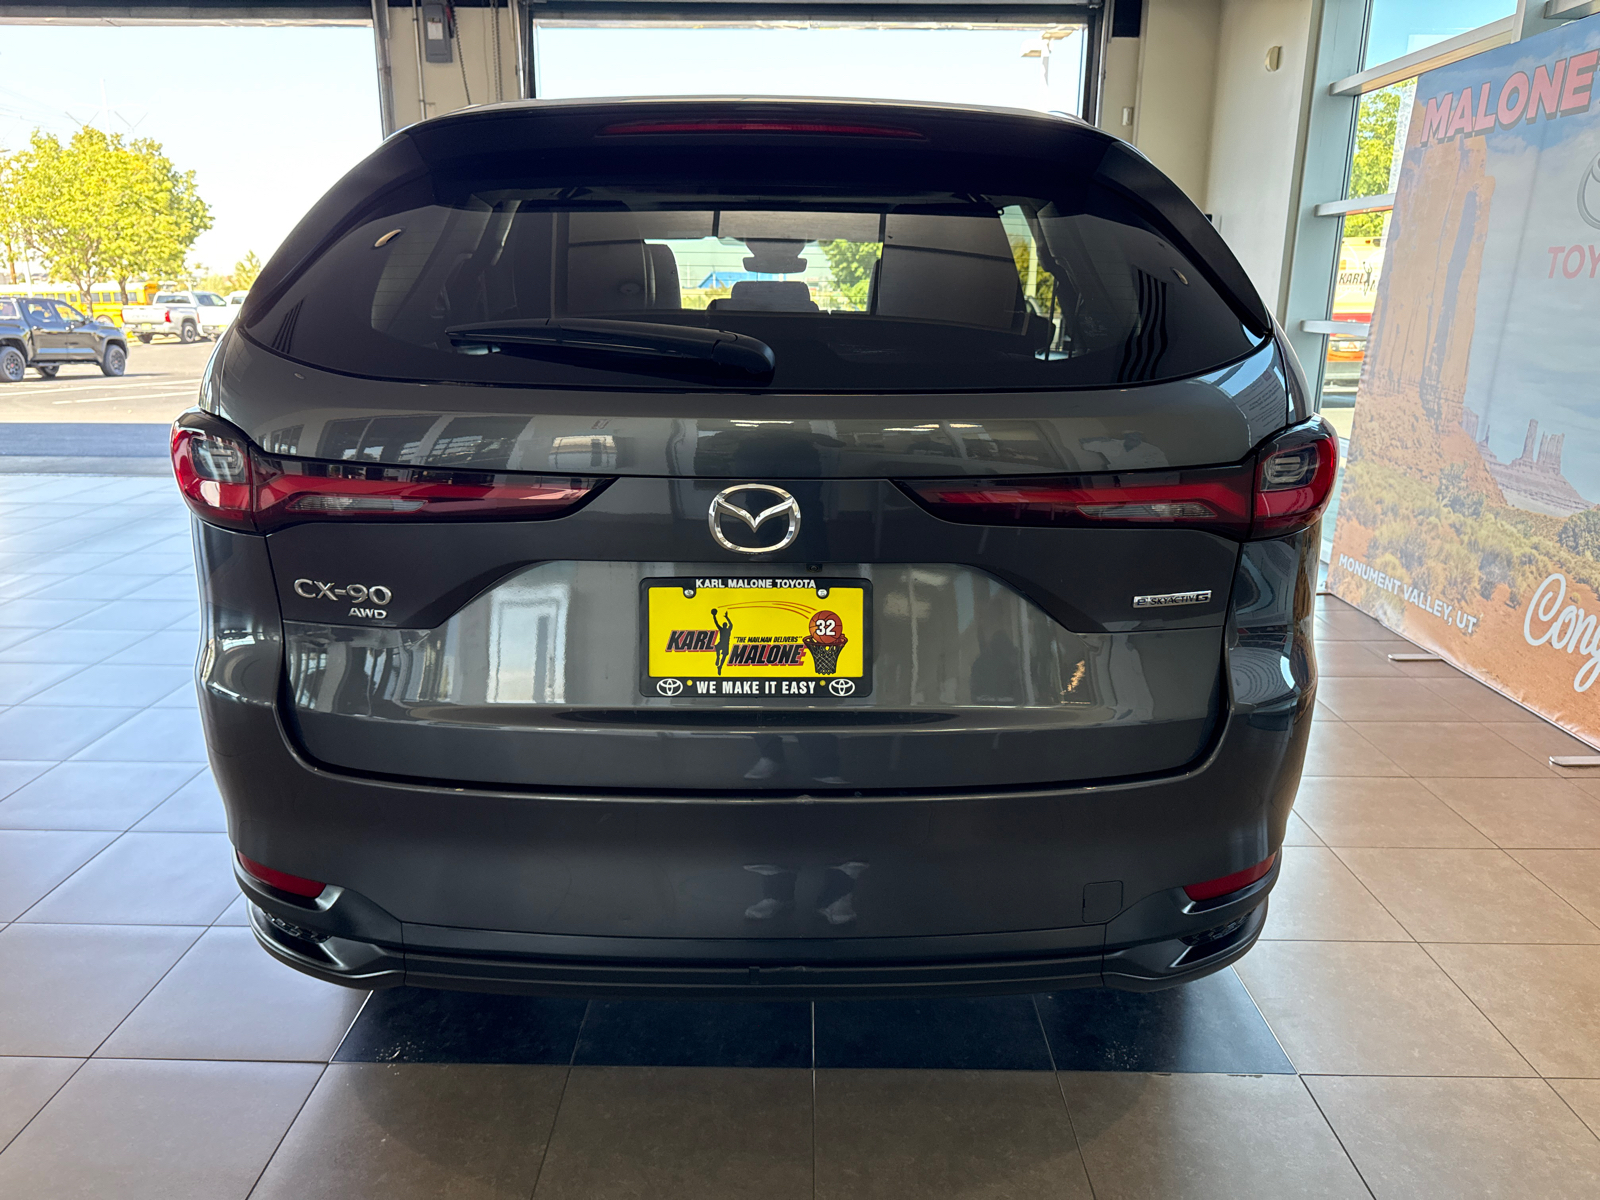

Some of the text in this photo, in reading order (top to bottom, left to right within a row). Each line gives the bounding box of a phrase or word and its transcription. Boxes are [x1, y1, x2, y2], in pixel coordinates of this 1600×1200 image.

[1339, 272, 1365, 285] KARL
[294, 578, 392, 605] CX-90
[696, 579, 816, 589] KARL MALONE TOYOTA
[1339, 553, 1477, 633] MONUMENT VALLEY, UT
[348, 607, 387, 619] AWD
[816, 619, 836, 636] 32
[665, 630, 718, 652] KARL
[727, 644, 807, 666] MALONE
[696, 681, 816, 694] WE MAKE IT EASY
